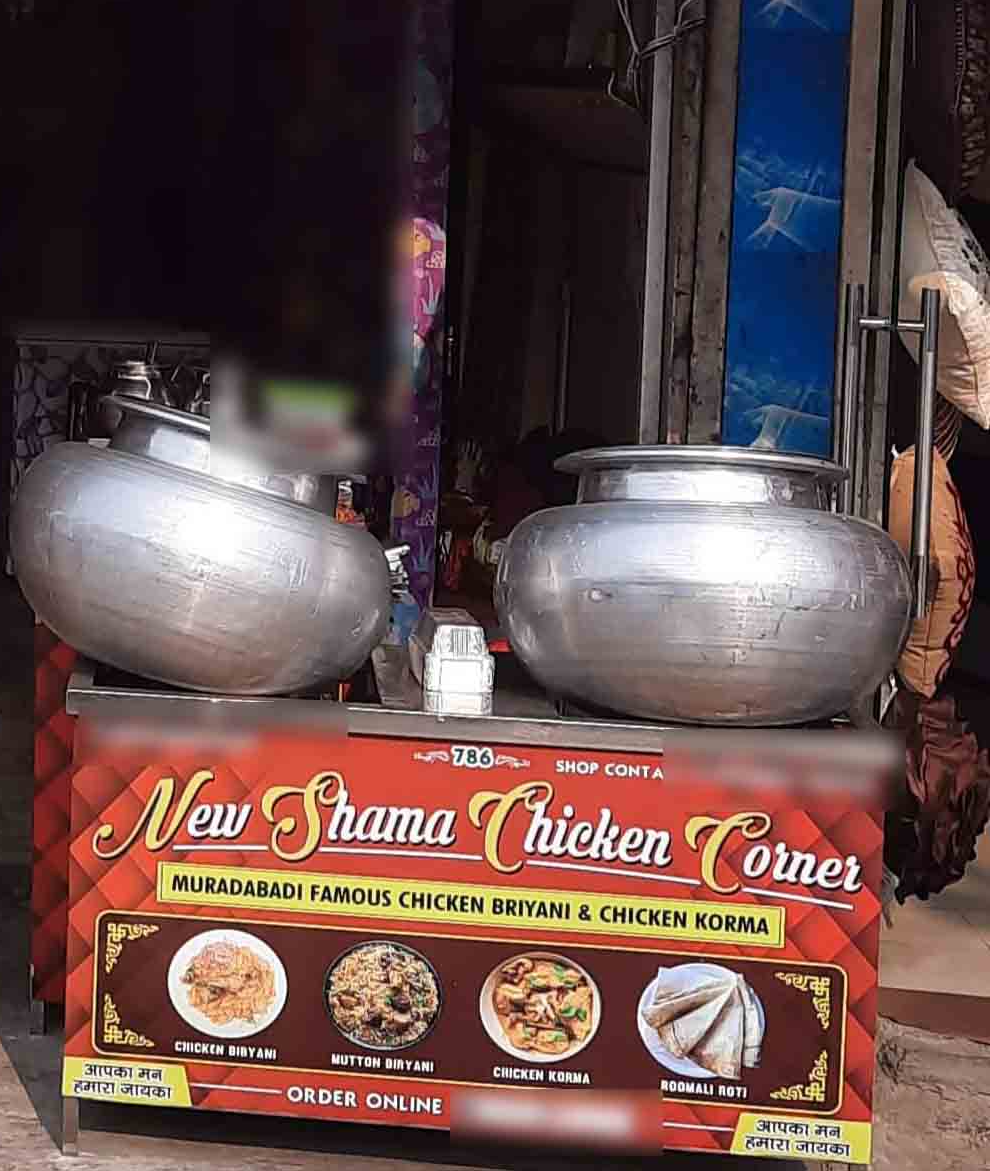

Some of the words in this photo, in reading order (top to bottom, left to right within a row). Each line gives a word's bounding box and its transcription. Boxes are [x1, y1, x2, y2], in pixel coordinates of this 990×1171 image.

[450, 745, 495, 769] 786
[556, 759, 599, 775] SHOP
[92, 770, 252, 859] New
[261, 771, 456, 861] Shama
[468, 780, 671, 873] Chicken
[684, 811, 862, 894] Corner
[171, 875, 303, 901] MURADABADI
[310, 884, 392, 907] FAMOUS
[398, 891, 484, 914] CHICKEN
[492, 897, 571, 920] BRIYANI
[578, 904, 591, 921] &
[599, 905, 687, 928] CHICKEN
[695, 912, 769, 935] KORMA
[174, 1041, 224, 1055] CHICKEN
[228, 1045, 277, 1060] BIRYANI
[84, 1063, 133, 1079] आपका
[138, 1068, 162, 1081] मन
[331, 1053, 381, 1068] MUTTON
[385, 1058, 434, 1072] BIRYANI
[493, 1066, 544, 1081] CHICKEN
[548, 1070, 590, 1085] KORMA
[74, 1080, 115, 1094] हमारा
[120, 1083, 171, 1098] जायका
[660, 1080, 714, 1096] ROOMALI
[718, 1085, 747, 1098] ROTI
[287, 1086, 357, 1107] ORDER
[366, 1093, 442, 1114] ONLINE
[757, 1120, 809, 1136] आपका
[814, 1125, 841, 1139] मन
[745, 1136, 790, 1150] हमारा
[796, 1140, 850, 1157] जायका
